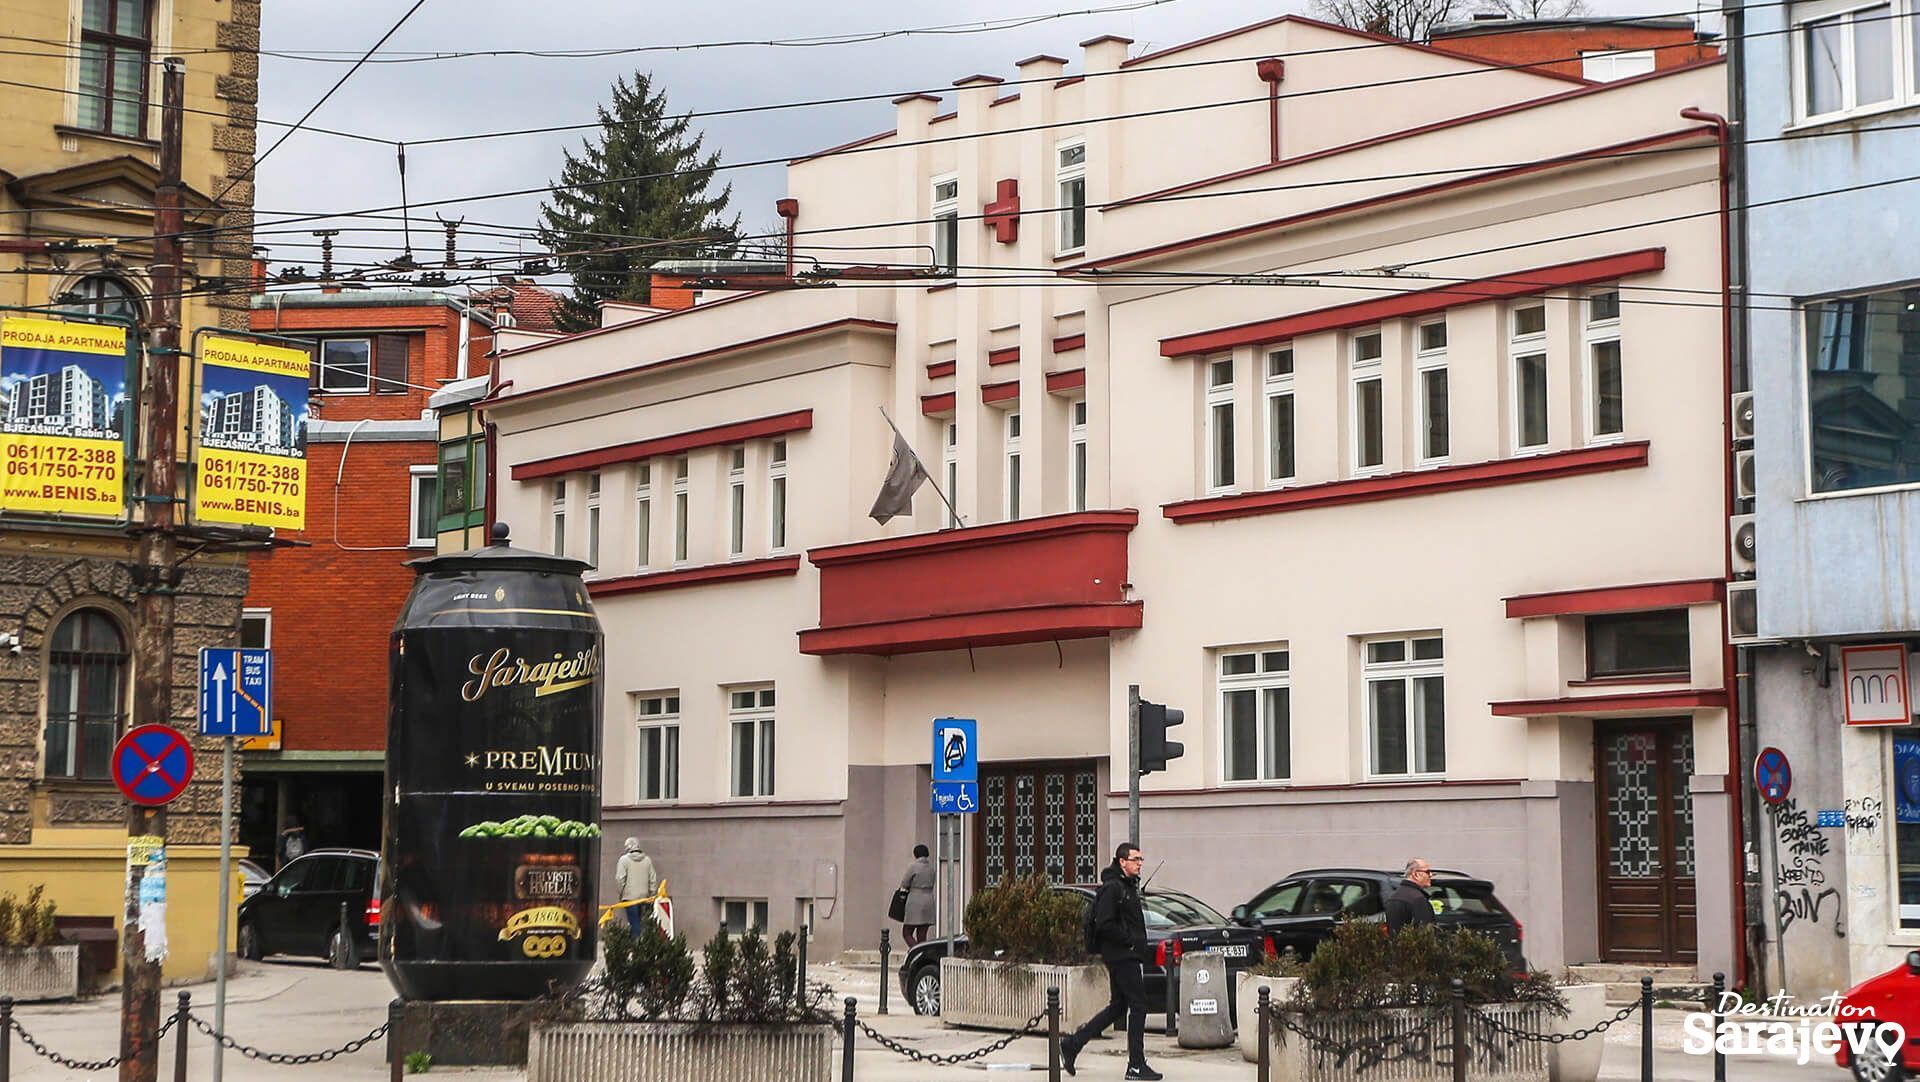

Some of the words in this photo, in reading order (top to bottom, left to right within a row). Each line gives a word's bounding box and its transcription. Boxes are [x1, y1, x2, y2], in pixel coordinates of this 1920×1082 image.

[3, 331, 56, 344] PRODAJA
[58, 335, 125, 349] APARTMANA
[204, 349, 249, 364] PRODAJA
[251, 357, 309, 373] APARTMANA
[75, 428, 104, 438] Babin
[106, 430, 119, 439] Do
[7, 444, 116, 464] 061/172-388
[264, 445, 289, 456] Babin
[291, 448, 303, 457] Do
[7, 460, 116, 481] 061/750-770
[205, 457, 300, 481] 061/172-388
[4, 484, 117, 503] www.BENIS.ba
[204, 474, 299, 496] 061/750-770
[201, 498, 300, 517] www.BENIS.ba
[243, 655, 264, 664] TRAM
[245, 666, 261, 675] BUS
[245, 677, 262, 686] TAXI
[483, 745, 596, 776] PREMIUM
[485, 783, 493, 791] U
[497, 783, 535, 791] SVEMU
[538, 783, 579, 792] POSEBNO
[547, 871, 574, 882] VRSTE
[529, 881, 573, 895] HMELJA
